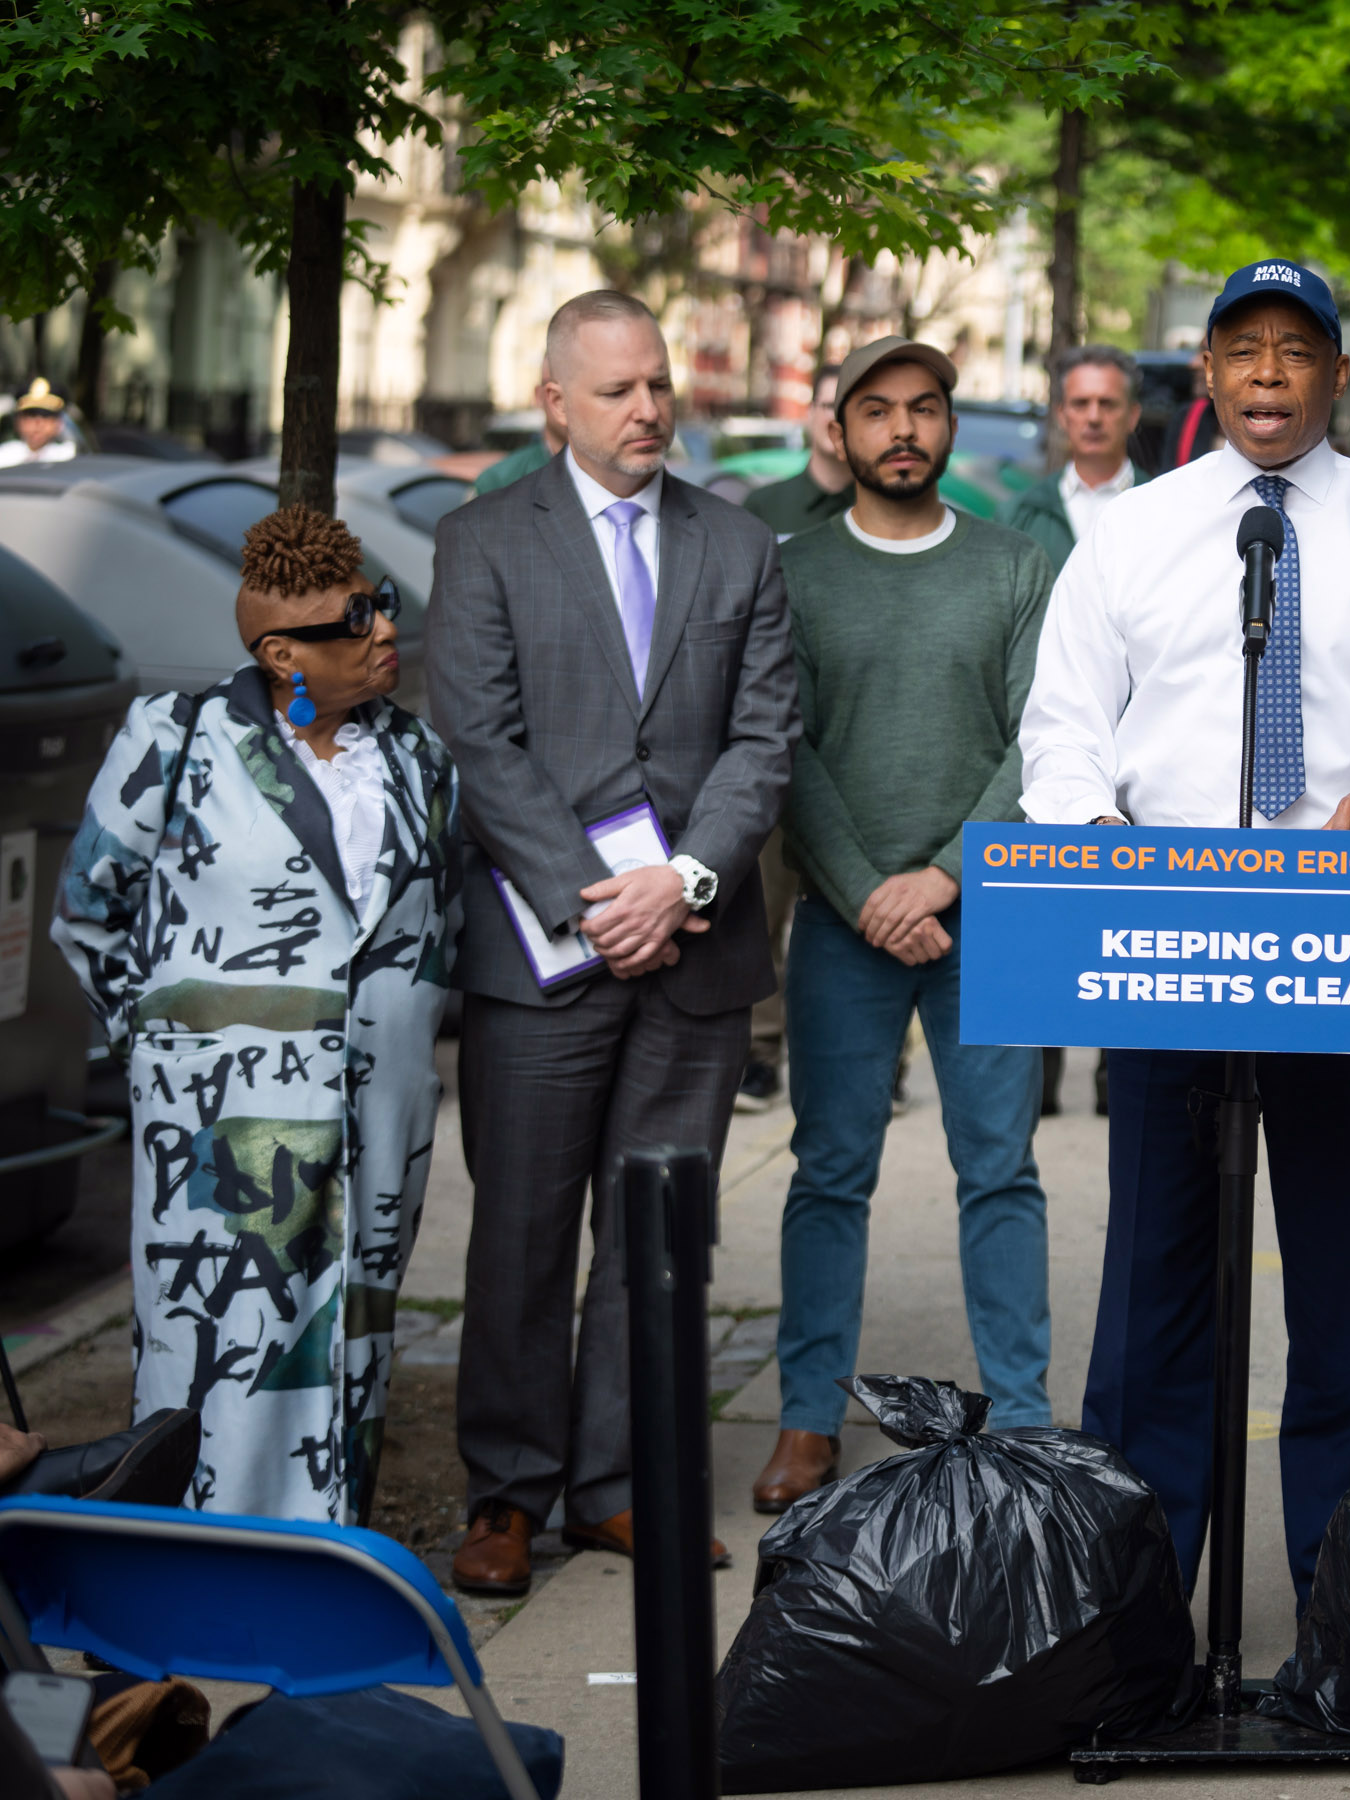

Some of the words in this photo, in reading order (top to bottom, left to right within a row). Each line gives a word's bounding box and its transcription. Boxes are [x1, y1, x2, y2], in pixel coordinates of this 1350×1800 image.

[1252, 272, 1301, 287] ADAMS
[1255, 265, 1301, 279] MAYOR
[983, 842, 1100, 870] OFFICE
[1111, 845, 1156, 871] OF
[1168, 847, 1286, 874] MAYOR
[1101, 929, 1280, 962] KEEPING
[1077, 971, 1255, 1004] STREETS
